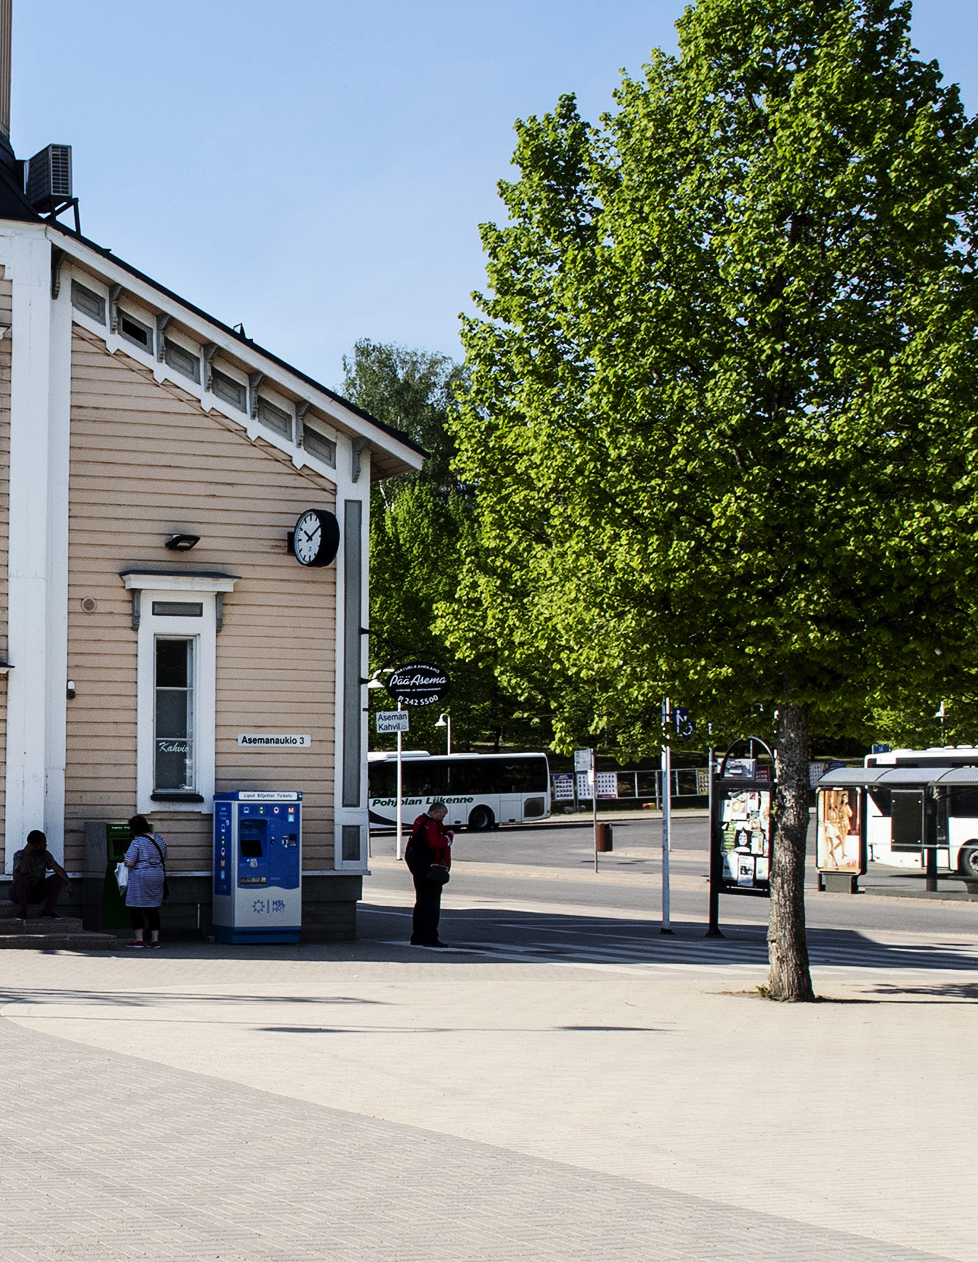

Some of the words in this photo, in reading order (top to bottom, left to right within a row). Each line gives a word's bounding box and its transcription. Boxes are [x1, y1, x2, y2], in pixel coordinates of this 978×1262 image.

[404, 698, 419, 706] 242
[420, 694, 439, 706] 5500
[378, 713, 408, 722] Aseman
[241, 736, 297, 745] Asemanaukio
[299, 736, 305, 745] 3
[273, 899, 285, 907] HSL
